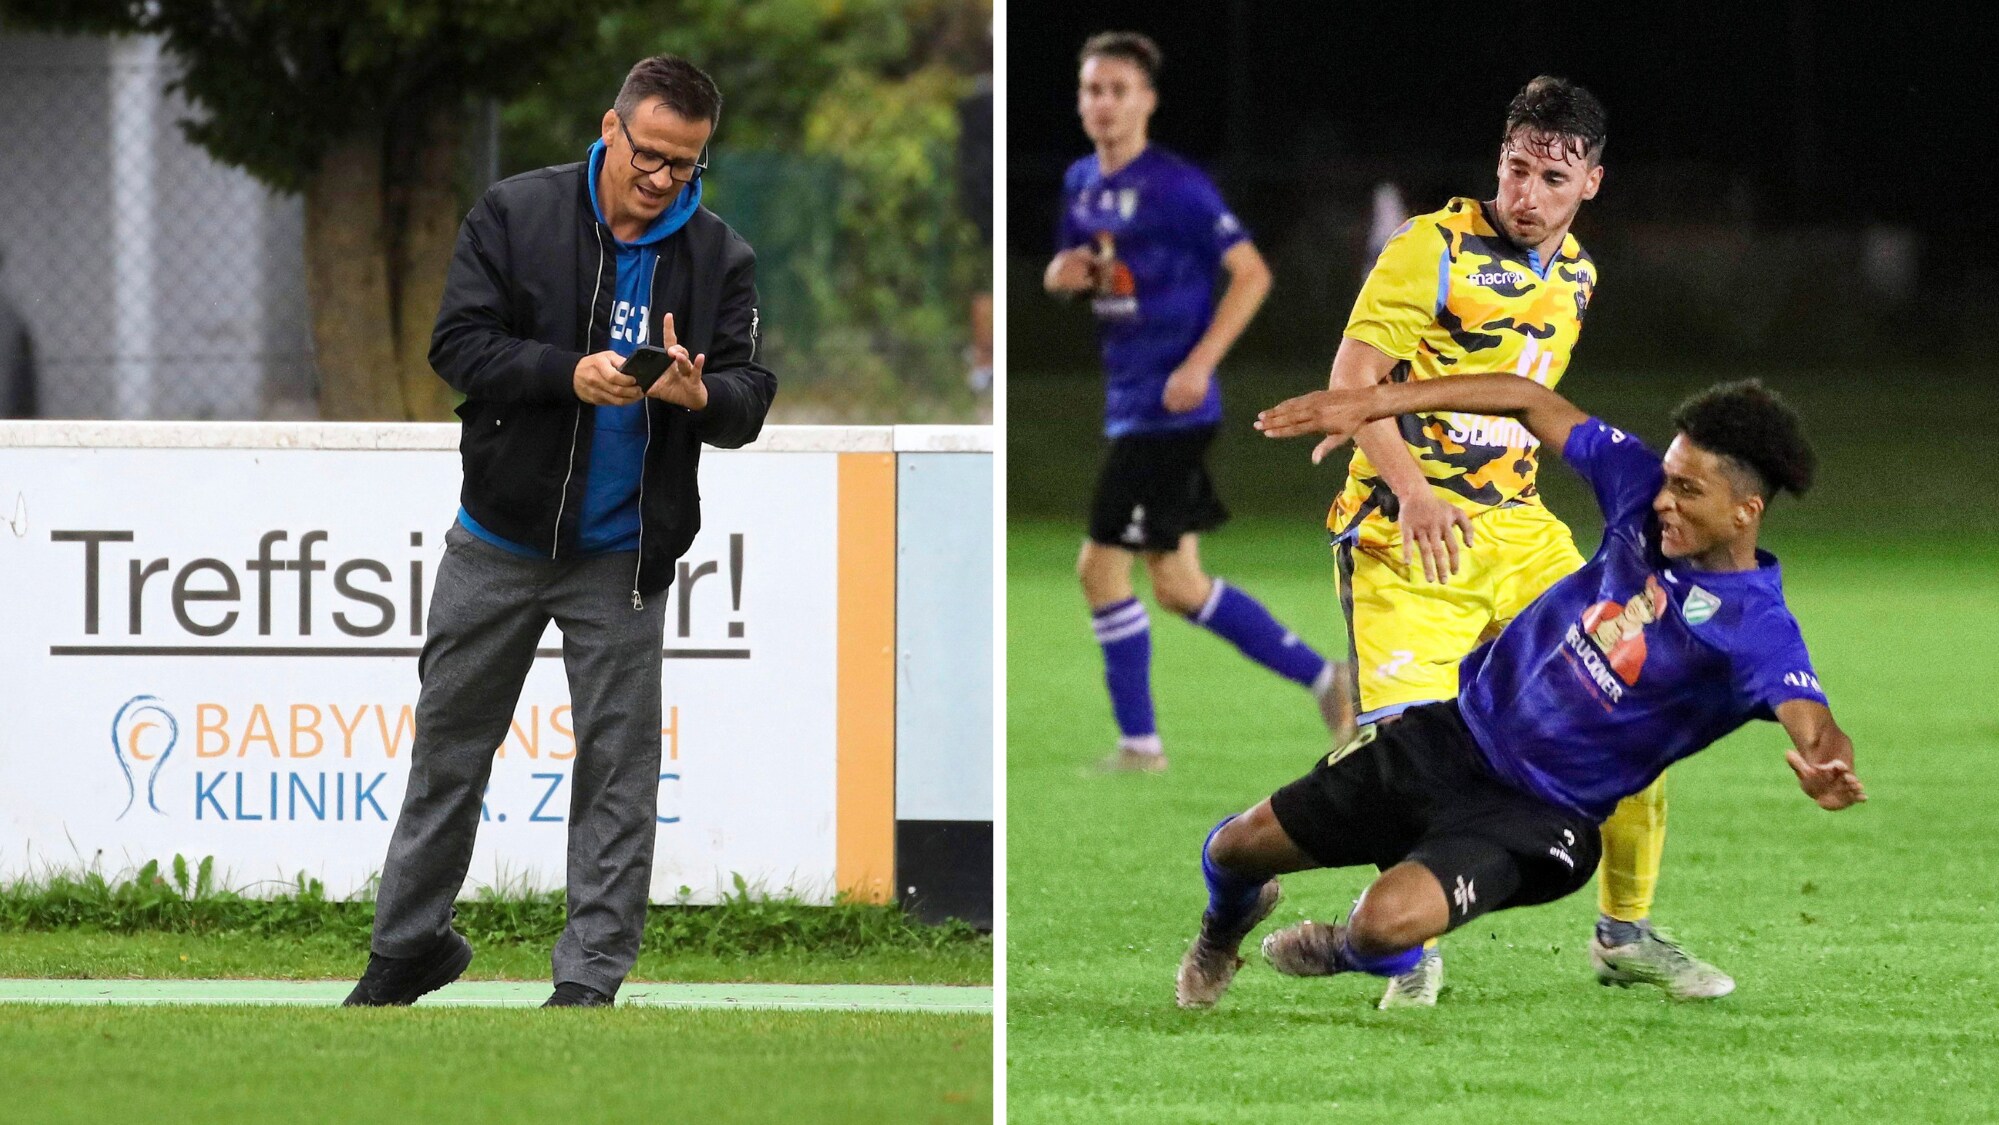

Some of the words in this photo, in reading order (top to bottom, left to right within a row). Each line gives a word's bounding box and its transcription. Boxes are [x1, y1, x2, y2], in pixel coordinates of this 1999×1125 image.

[50, 530, 745, 638] Treffsir!
[196, 703, 679, 761] BABYWNSH
[196, 771, 389, 821] KLINIK
